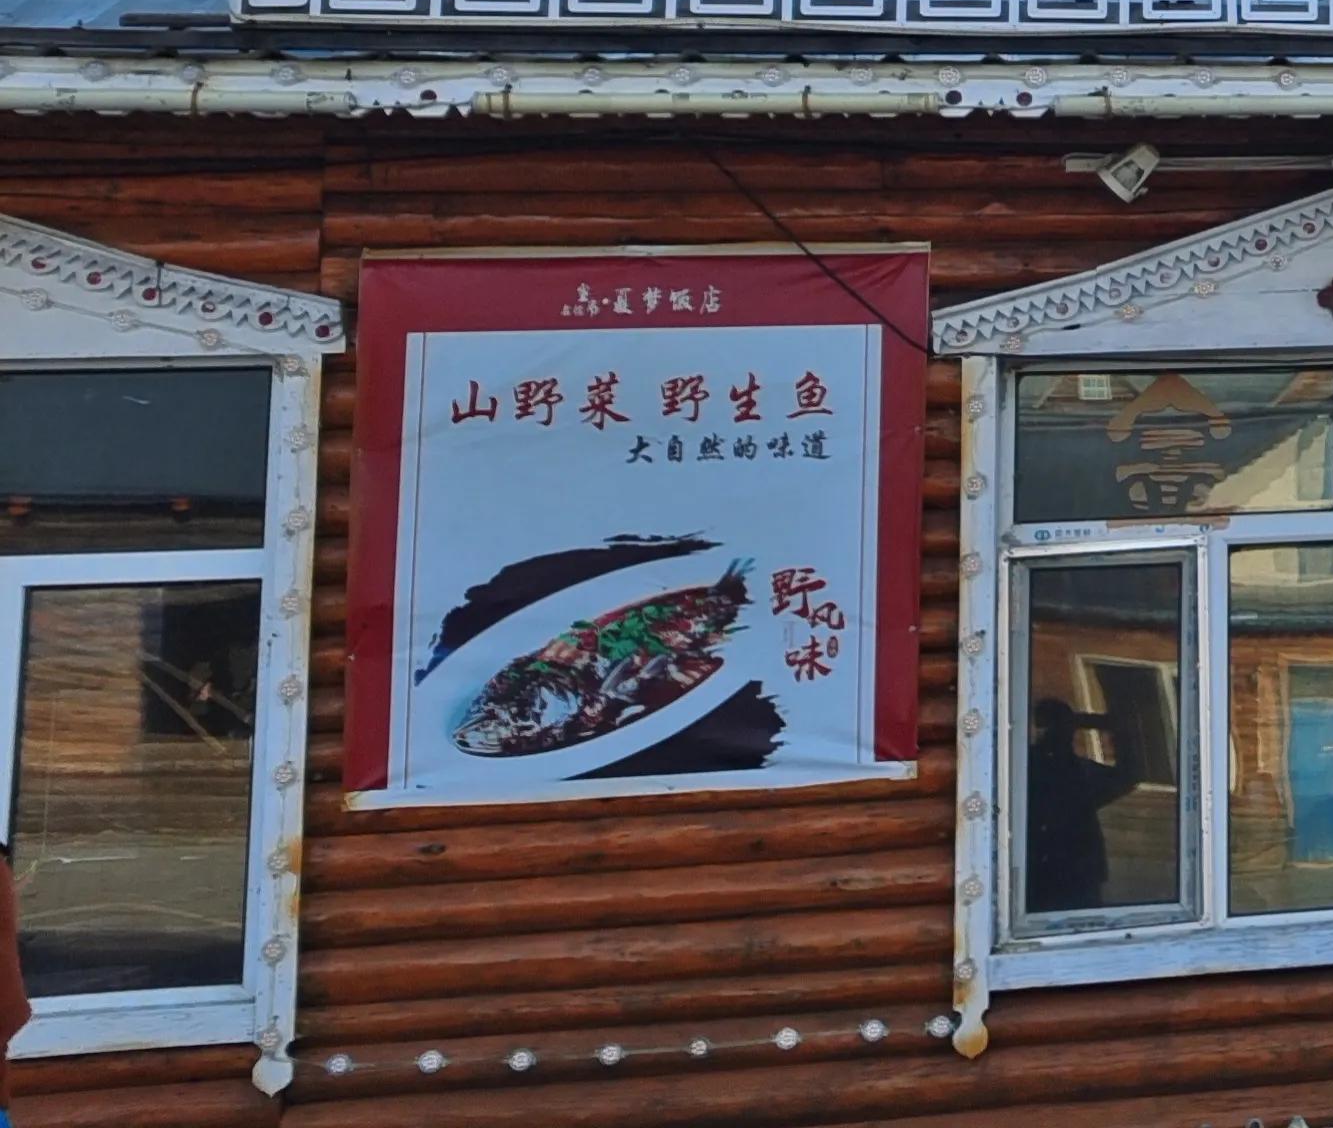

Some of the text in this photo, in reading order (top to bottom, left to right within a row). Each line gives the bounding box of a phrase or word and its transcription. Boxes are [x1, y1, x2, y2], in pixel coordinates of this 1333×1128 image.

[450, 371, 834, 430] 山野菜 野生鱼
[625, 430, 831, 464] 大自然的味道
